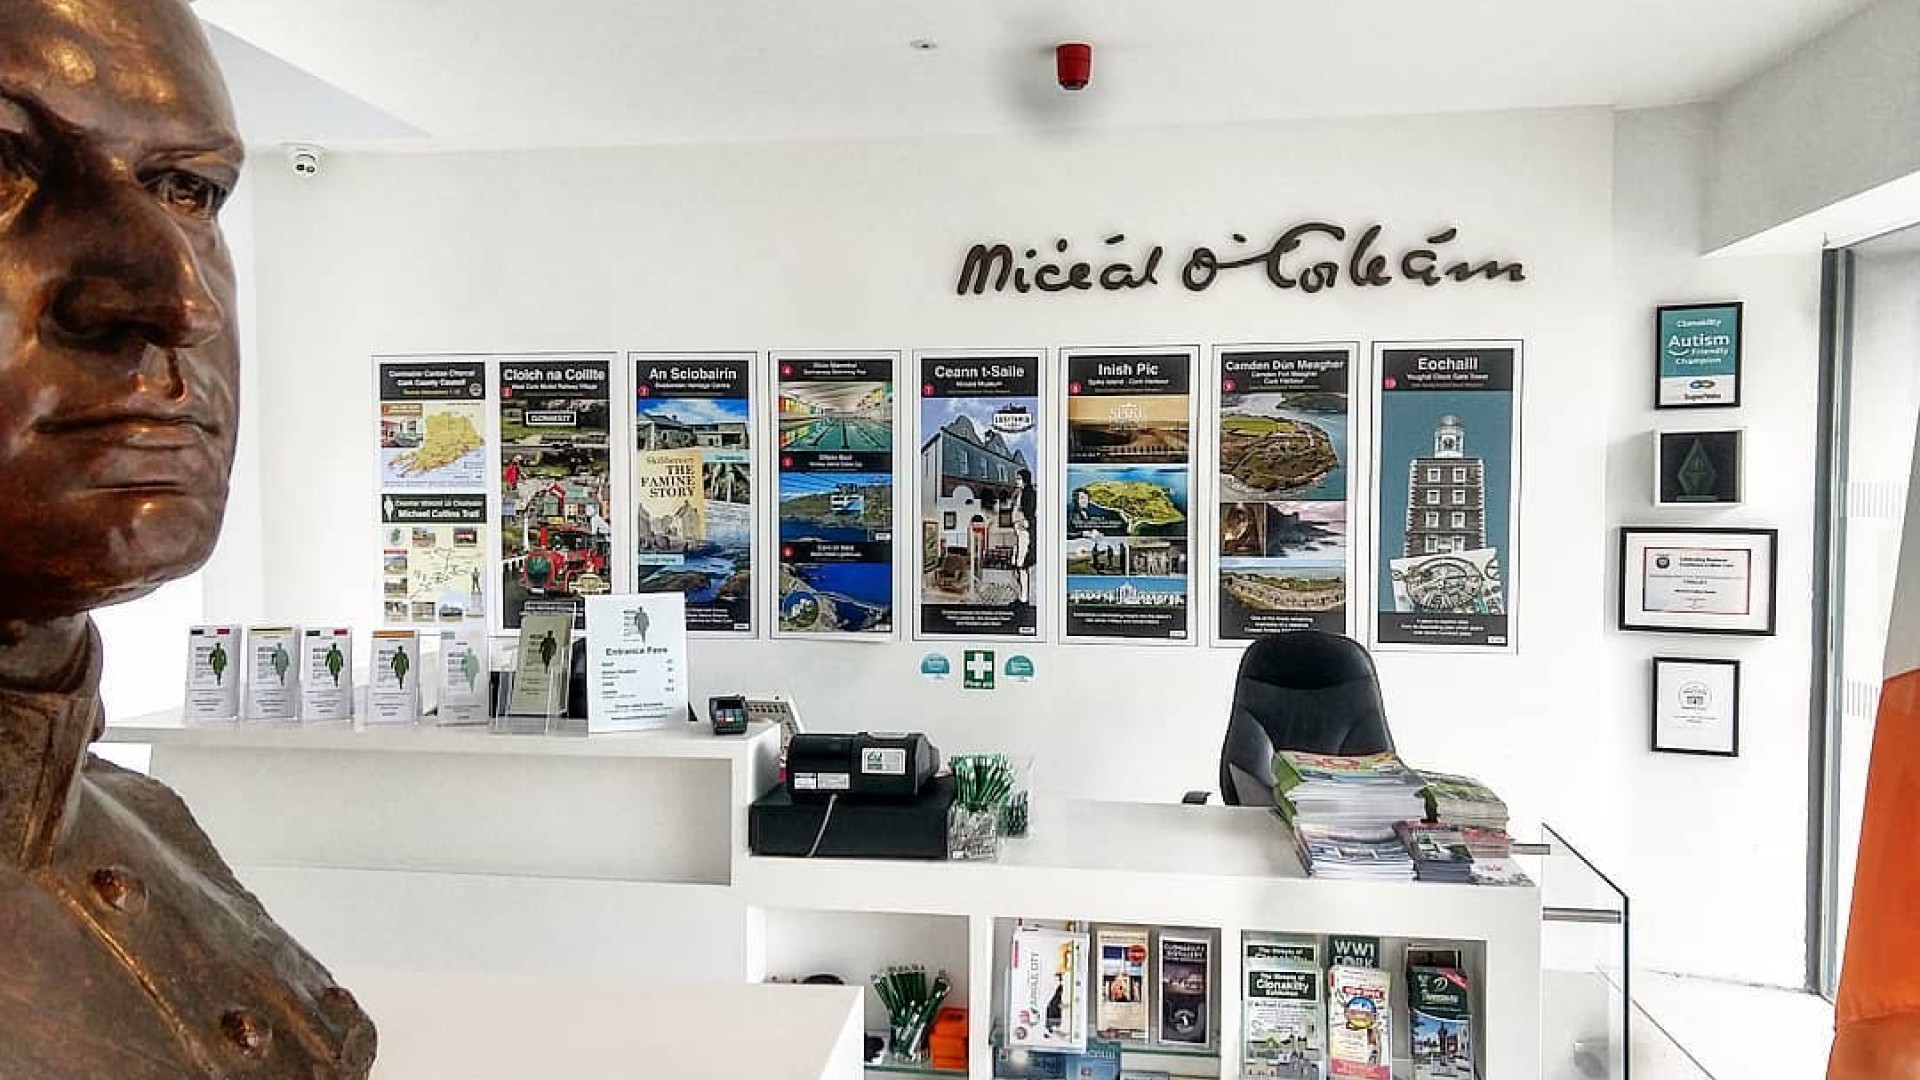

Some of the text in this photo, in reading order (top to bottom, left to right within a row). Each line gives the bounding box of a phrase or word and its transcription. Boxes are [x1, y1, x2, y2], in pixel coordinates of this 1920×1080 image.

[1668, 333, 1730, 348] Autism
[1691, 347, 1729, 356] Friendly
[1225, 359, 1344, 372] Camden Dún Meagher
[1417, 356, 1479, 371] Eochaill
[1675, 357, 1722, 365] Champion
[504, 368, 543, 381] Cloich
[546, 370, 563, 381] na
[649, 366, 737, 380] An Sciobairín
[934, 365, 979, 378] Ceann
[1097, 362, 1159, 376] Inish Pic
[664, 464, 696, 475] THE
[640, 475, 696, 487] FAMINE
[648, 486, 696, 498] STORY
[397, 509, 431, 518] Michael
[431, 509, 461, 518] Collins
[605, 647, 645, 656] Entrance
[1256, 978, 1309, 994] Clonakilty
